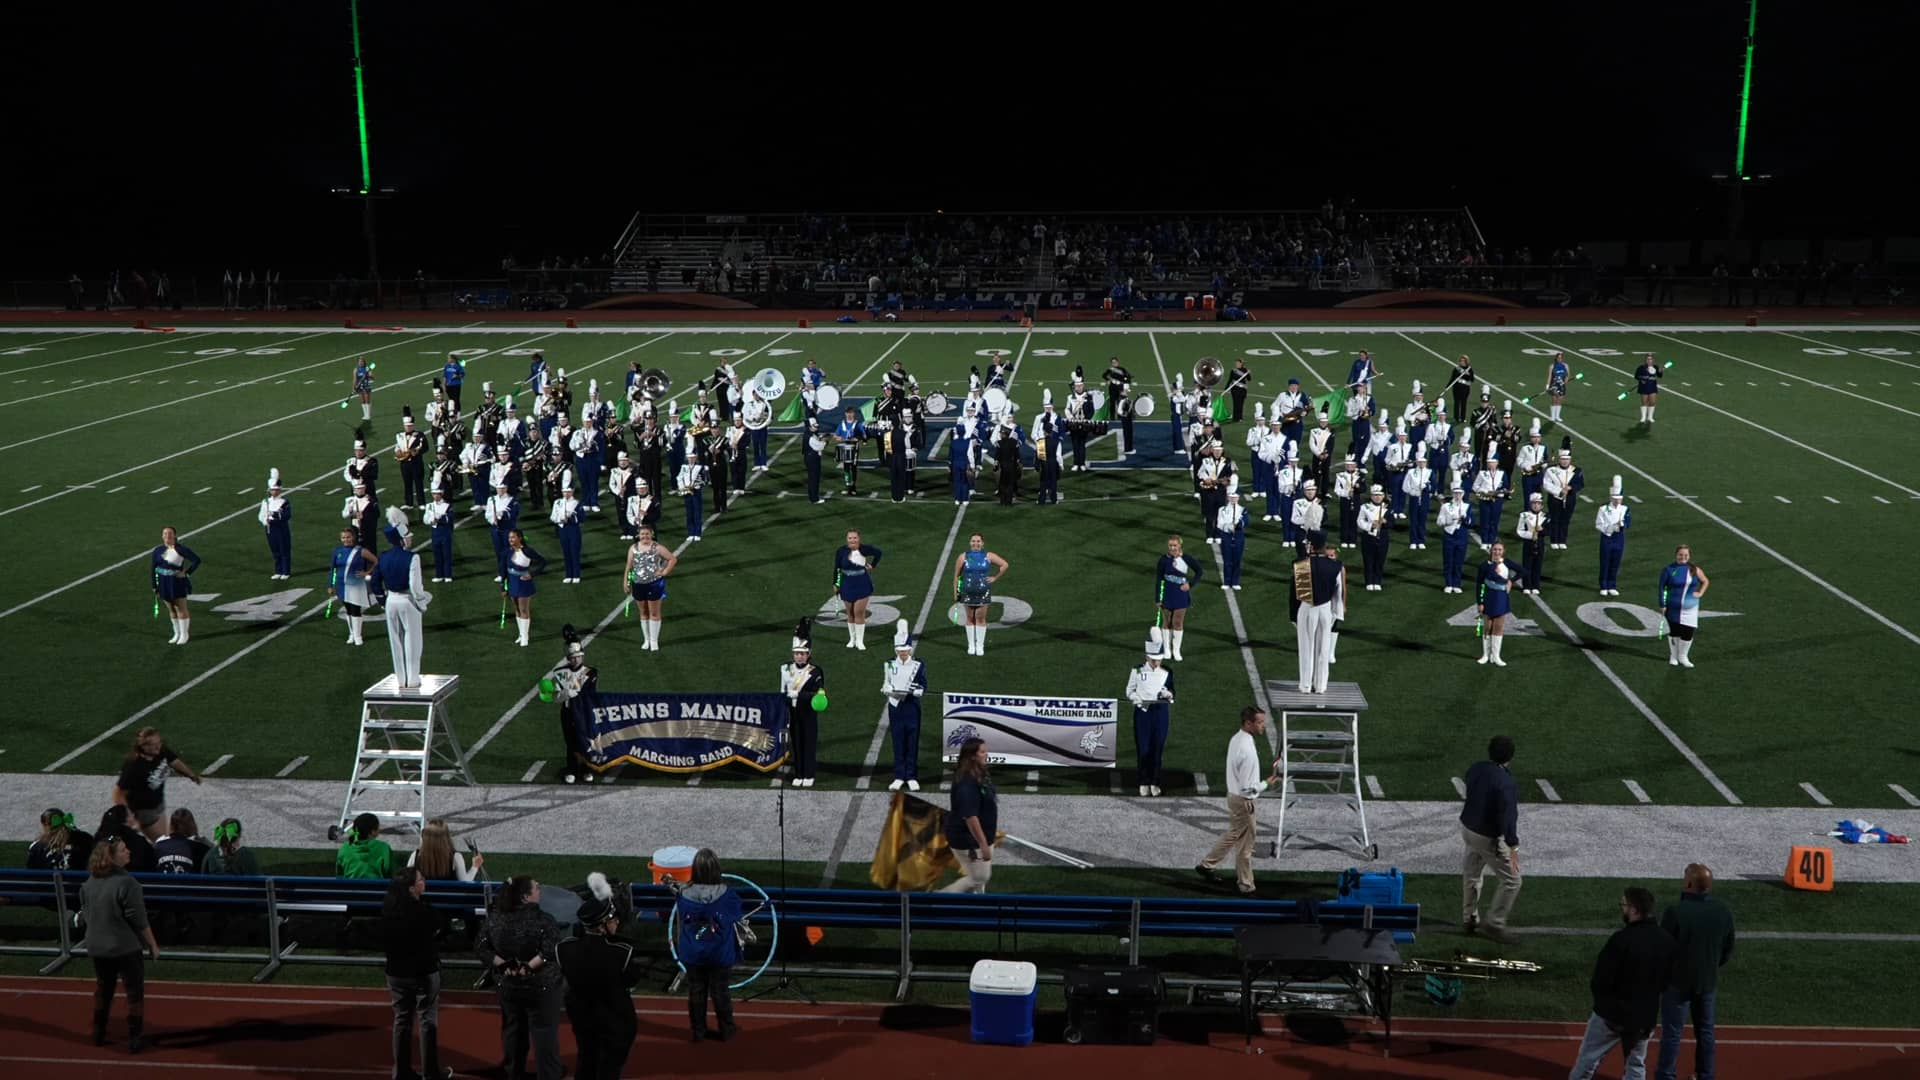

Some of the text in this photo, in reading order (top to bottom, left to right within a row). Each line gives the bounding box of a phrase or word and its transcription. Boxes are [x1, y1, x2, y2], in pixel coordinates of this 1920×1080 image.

[756, 384, 783, 397] UNITED
[947, 695, 1113, 710] UNITED VALLEY
[592, 702, 762, 725] PENNS MANOR
[1034, 708, 1113, 719] MARCHING BAND
[628, 745, 734, 767] MARCHING BAND
[1799, 850, 1825, 885] 40
